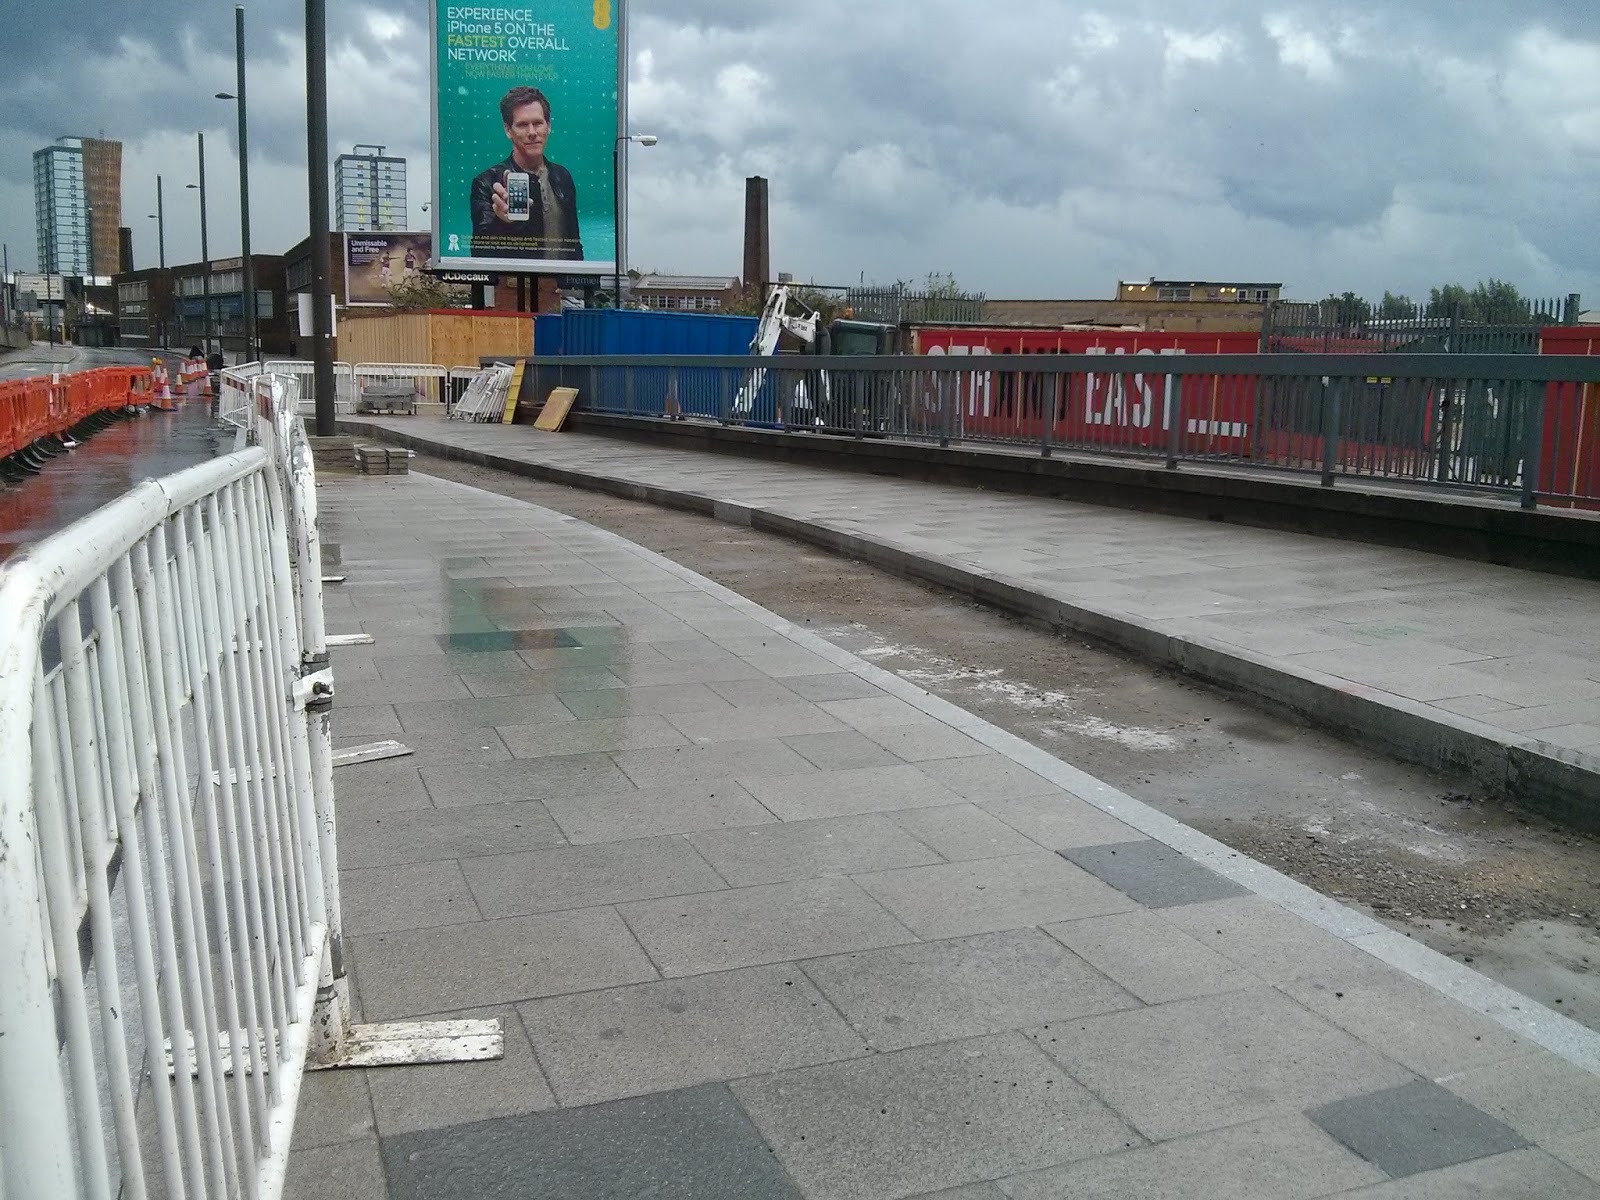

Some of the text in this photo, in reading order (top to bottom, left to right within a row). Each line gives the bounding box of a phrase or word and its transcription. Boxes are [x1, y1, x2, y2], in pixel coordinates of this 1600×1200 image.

[447, 6, 532, 21] EXPERIENCE
[447, 20, 555, 36] iPhone 5 ON THE
[447, 34, 570, 51] FASTEST OVERALL
[447, 48, 517, 62] NETWORK
[442, 273, 489, 281] JCDecaux
[1085, 346, 1186, 431] EAST
